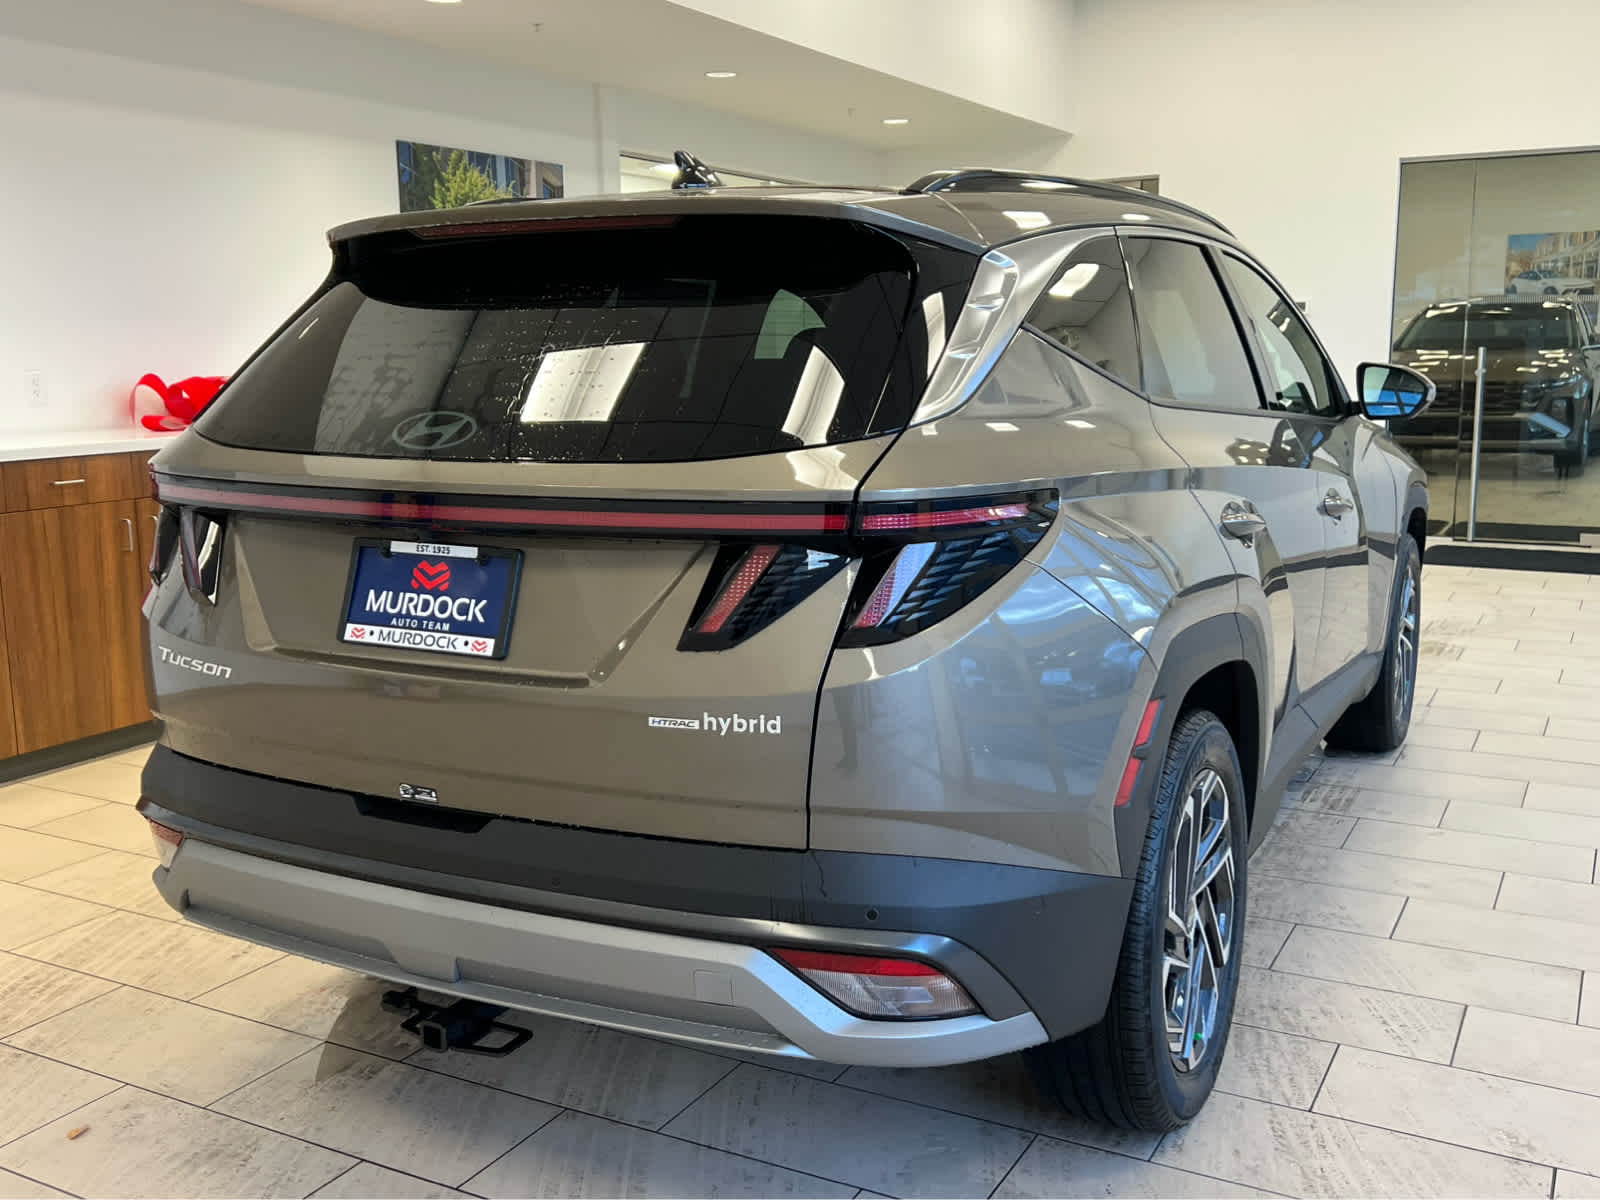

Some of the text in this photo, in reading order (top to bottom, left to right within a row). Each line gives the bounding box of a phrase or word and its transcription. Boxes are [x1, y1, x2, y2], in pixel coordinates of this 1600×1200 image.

[416, 543, 450, 555] EST. 1925
[365, 589, 487, 623] MURDOCK
[391, 617, 450, 632] AUTO TEAM
[377, 629, 459, 650] MURDOCK
[650, 711, 782, 736] HTRAC hybrid
